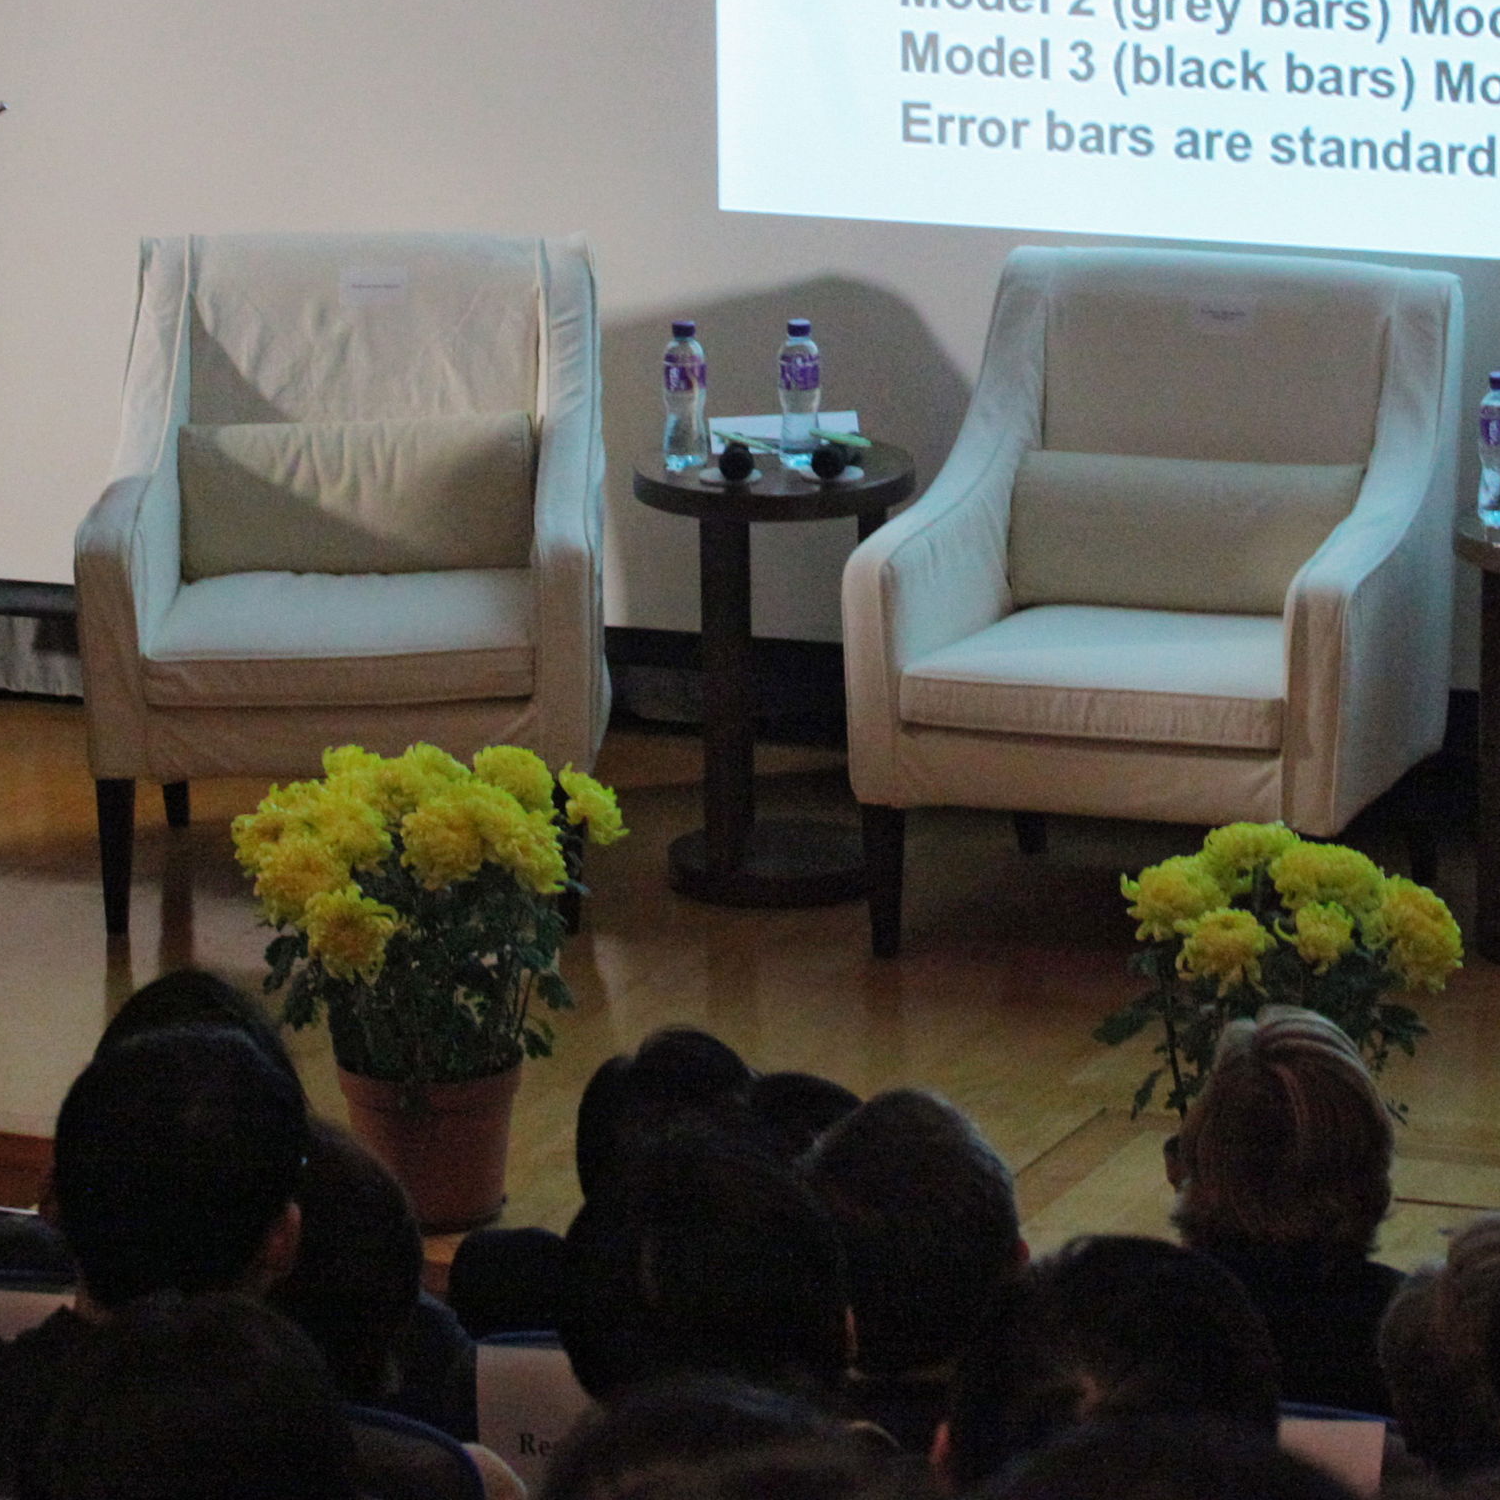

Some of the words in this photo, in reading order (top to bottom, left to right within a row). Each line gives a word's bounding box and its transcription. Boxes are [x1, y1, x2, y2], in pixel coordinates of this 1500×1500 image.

[900, 29, 1051, 80] Model
[1068, 39, 1096, 82] 3
[1113, 40, 1268, 97] (black
[1285, 51, 1416, 112] bars)
[901, 99, 1031, 150] Error
[1046, 108, 1156, 158] bars
[1174, 126, 1253, 163] are
[1270, 125, 1497, 178] standard
